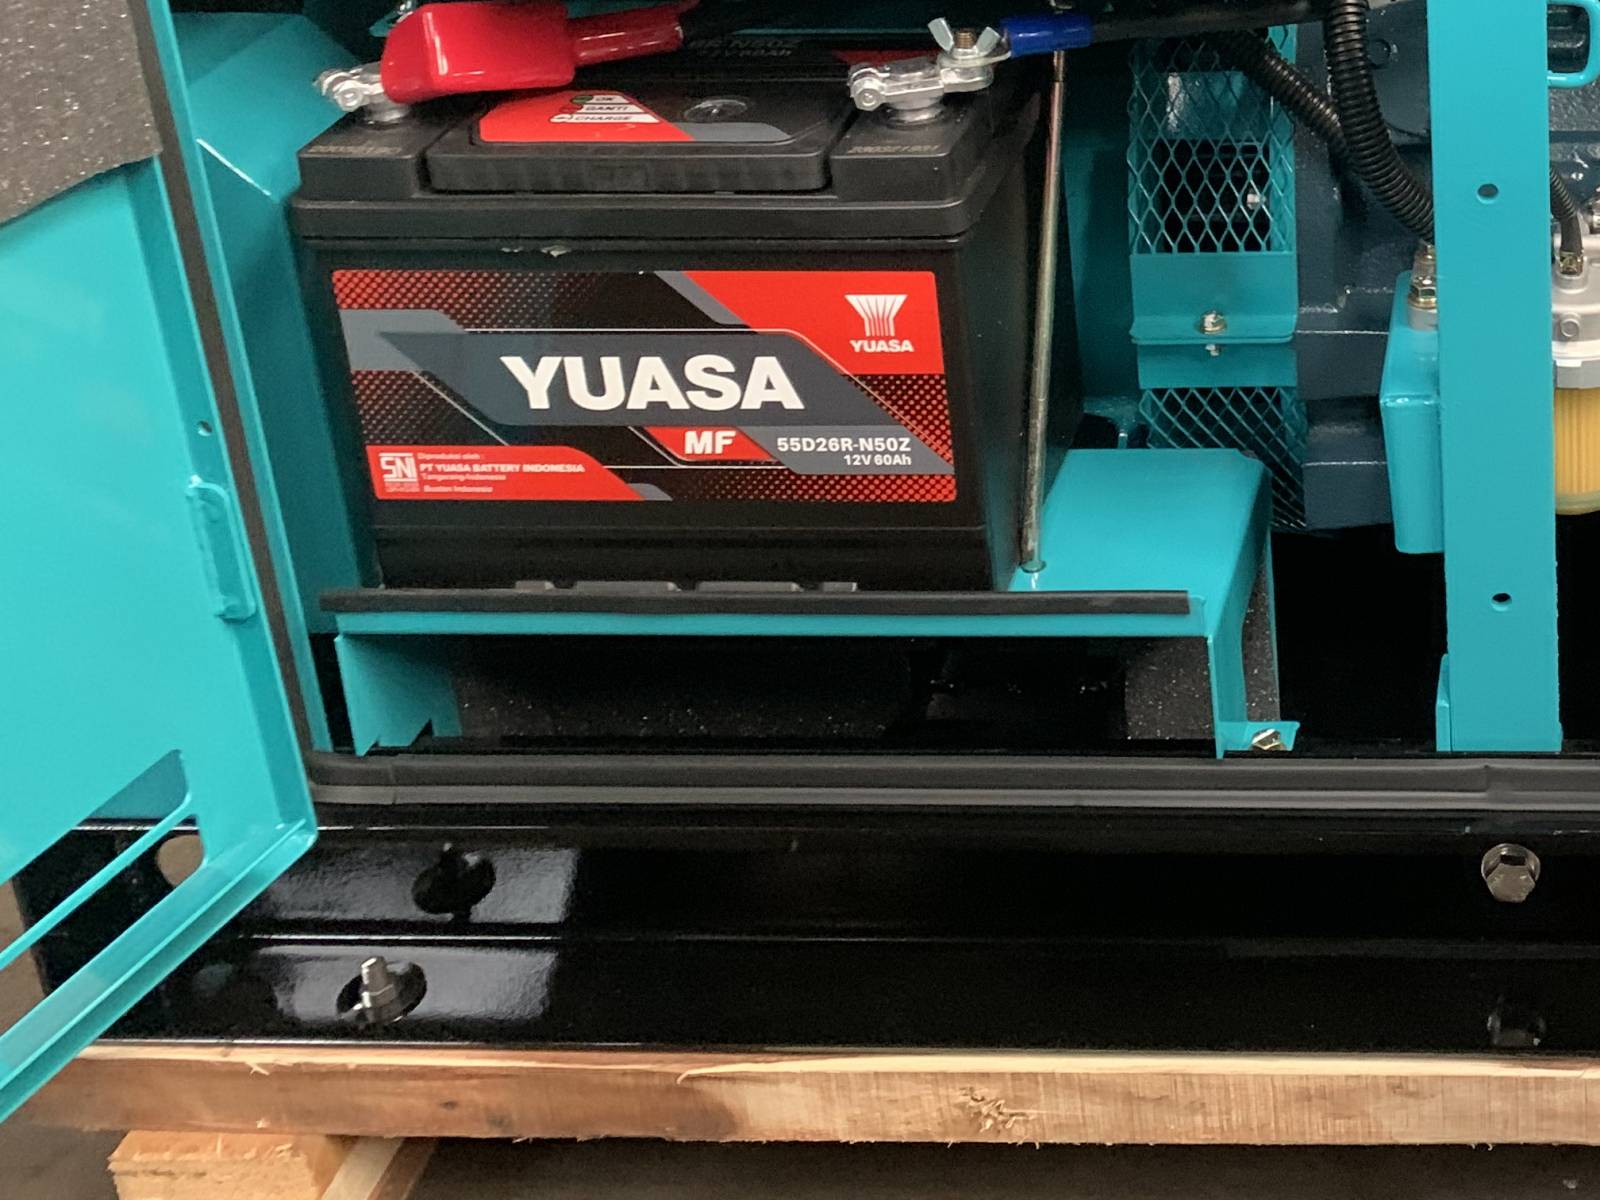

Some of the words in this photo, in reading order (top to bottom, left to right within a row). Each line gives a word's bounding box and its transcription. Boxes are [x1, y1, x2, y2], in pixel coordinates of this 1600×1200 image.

[849, 339, 914, 353] YUASA
[499, 355, 805, 411] YUASA
[684, 430, 737, 455] MF
[776, 437, 911, 453] 55D26R-N50Z
[380, 456, 418, 479] SNI
[419, 463, 434, 472] PT
[435, 463, 472, 473] YUASA
[472, 463, 521, 473] BATTERY
[522, 463, 586, 473] INDONESIA
[844, 454, 873, 466] 12V
[874, 454, 912, 466] 60Ah
